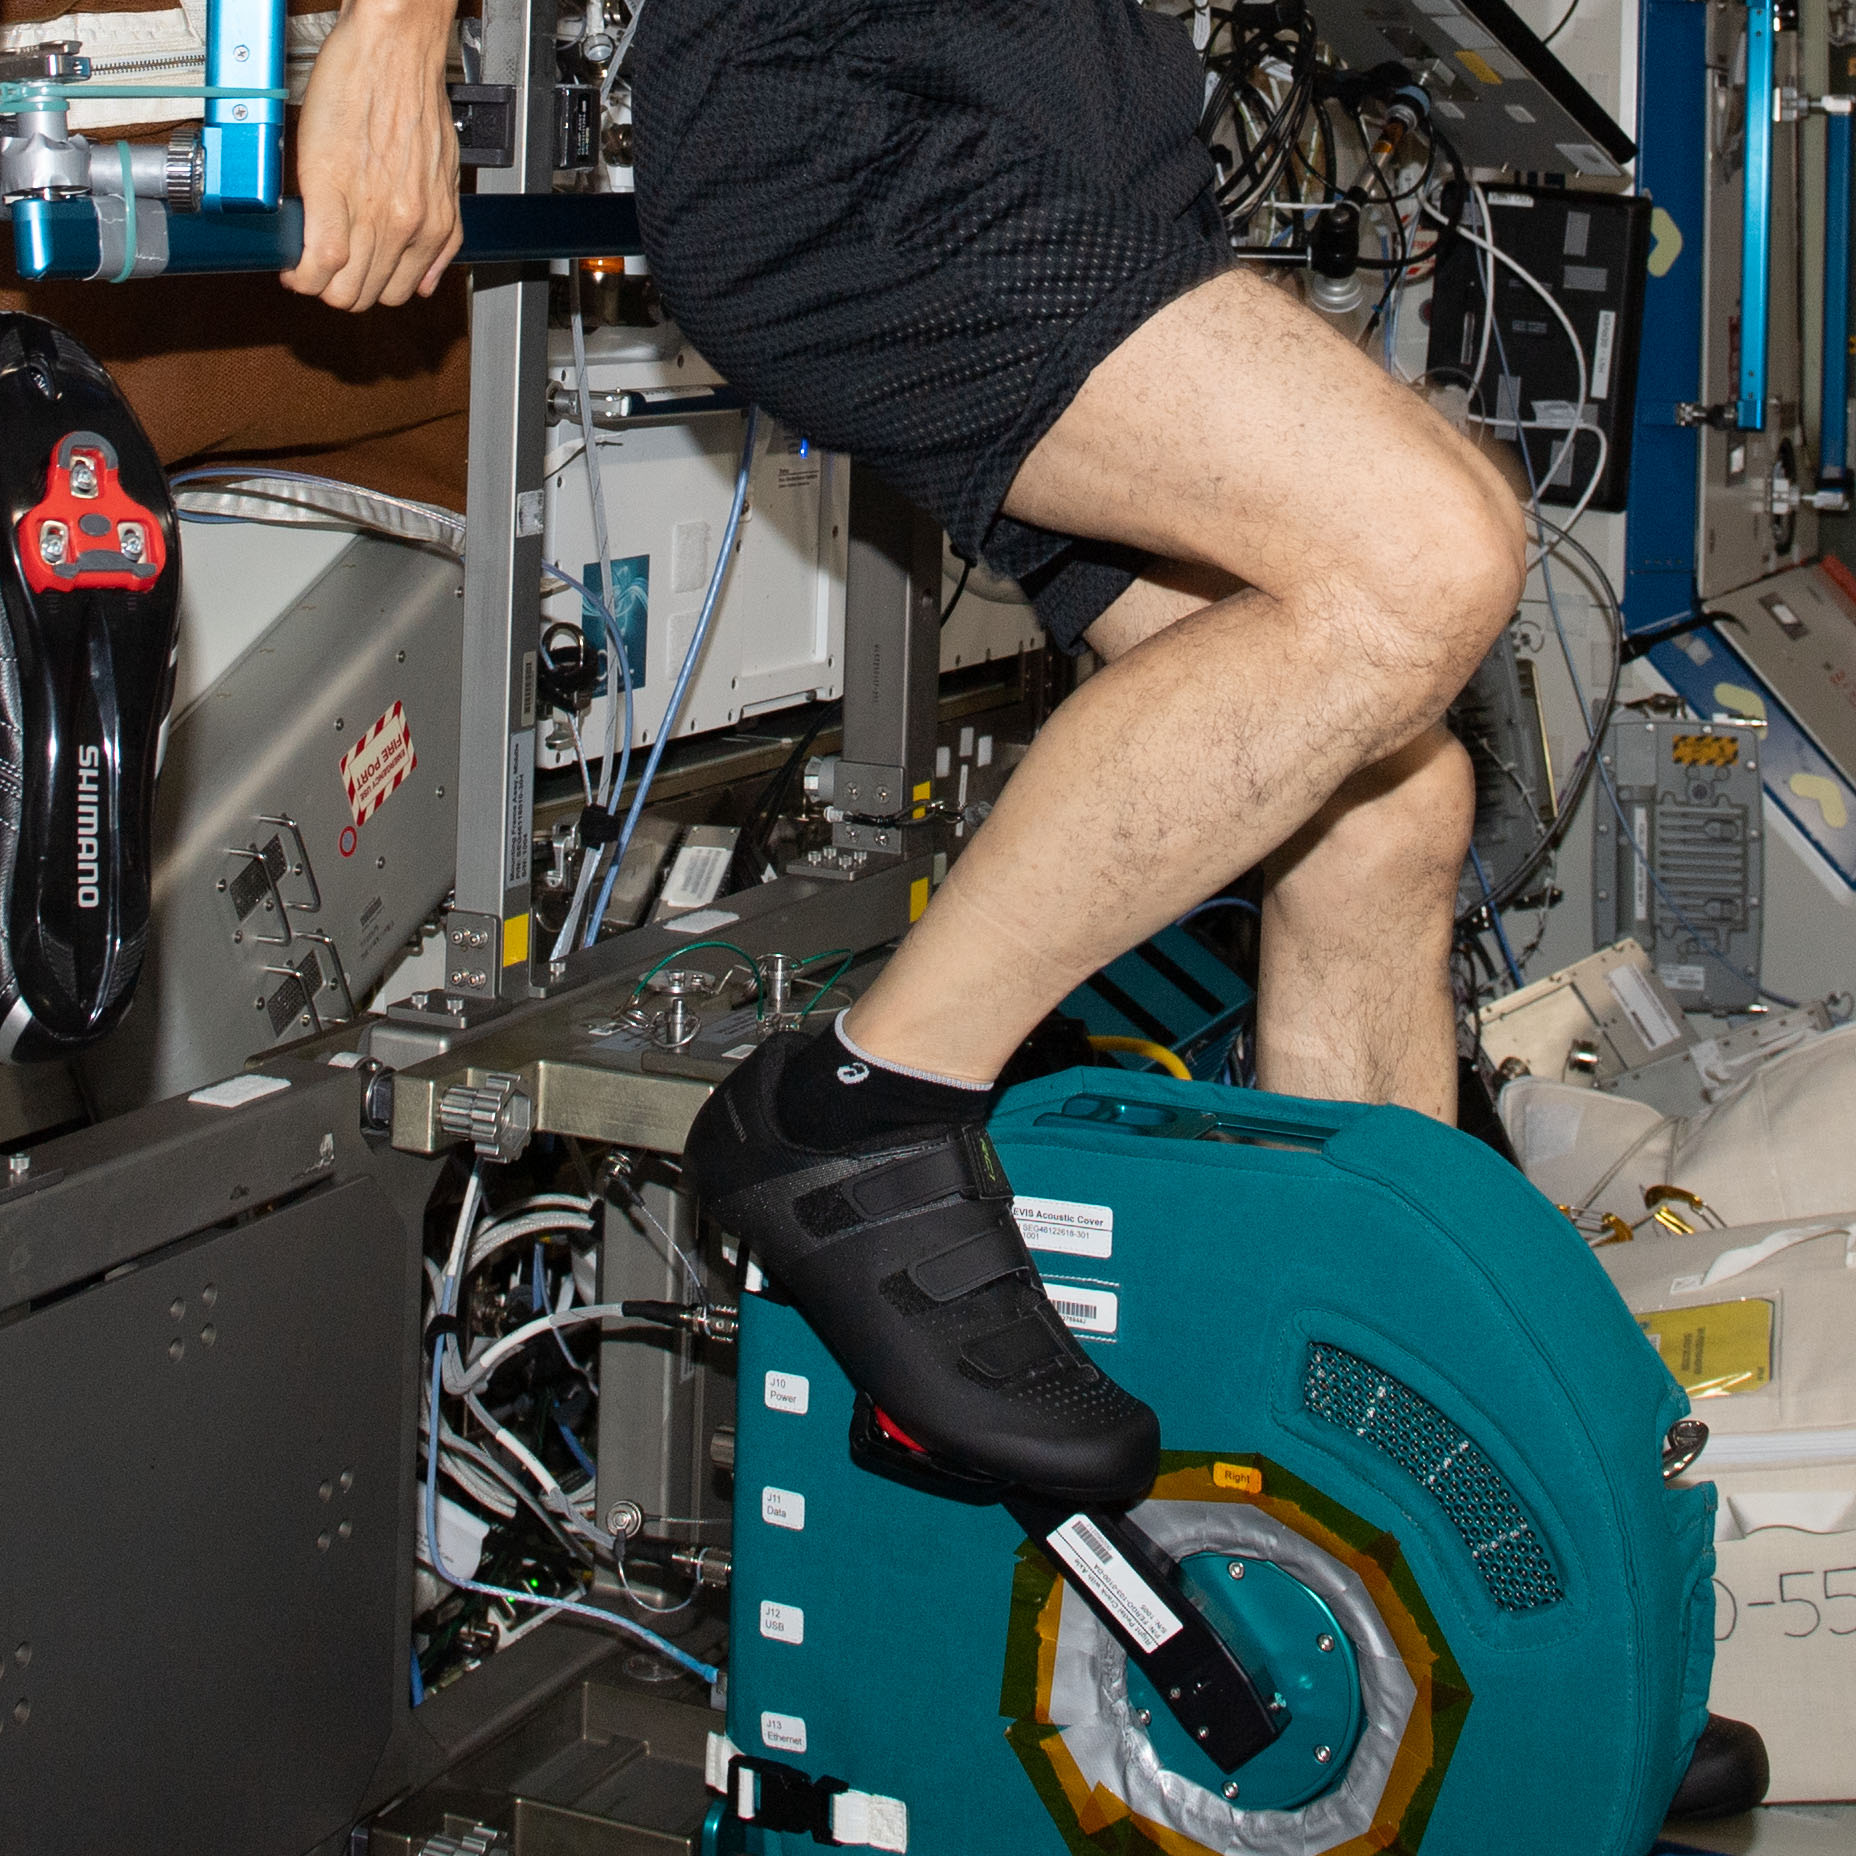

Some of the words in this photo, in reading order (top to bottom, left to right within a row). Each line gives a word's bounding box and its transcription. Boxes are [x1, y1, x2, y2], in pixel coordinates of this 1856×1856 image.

[380, 732, 404, 760] FIRE
[356, 760, 382, 791] PORT
[77, 744, 100, 908] SHIMANO
[1013, 1206, 1034, 1219] EVIS
[1036, 1210, 1075, 1223] Acoustic
[1077, 1215, 1104, 1227] Cover
[769, 1378, 786, 1389] J10
[770, 1390, 797, 1405] Power
[1223, 1469, 1251, 1486] Right
[766, 1494, 782, 1505] J11
[767, 1506, 788, 1519] Data
[765, 1606, 782, 1618] J12
[765, 1619, 785, 1633] USB
[766, 1718, 783, 1730] J13
[767, 1732, 803, 1746] Ethernet
